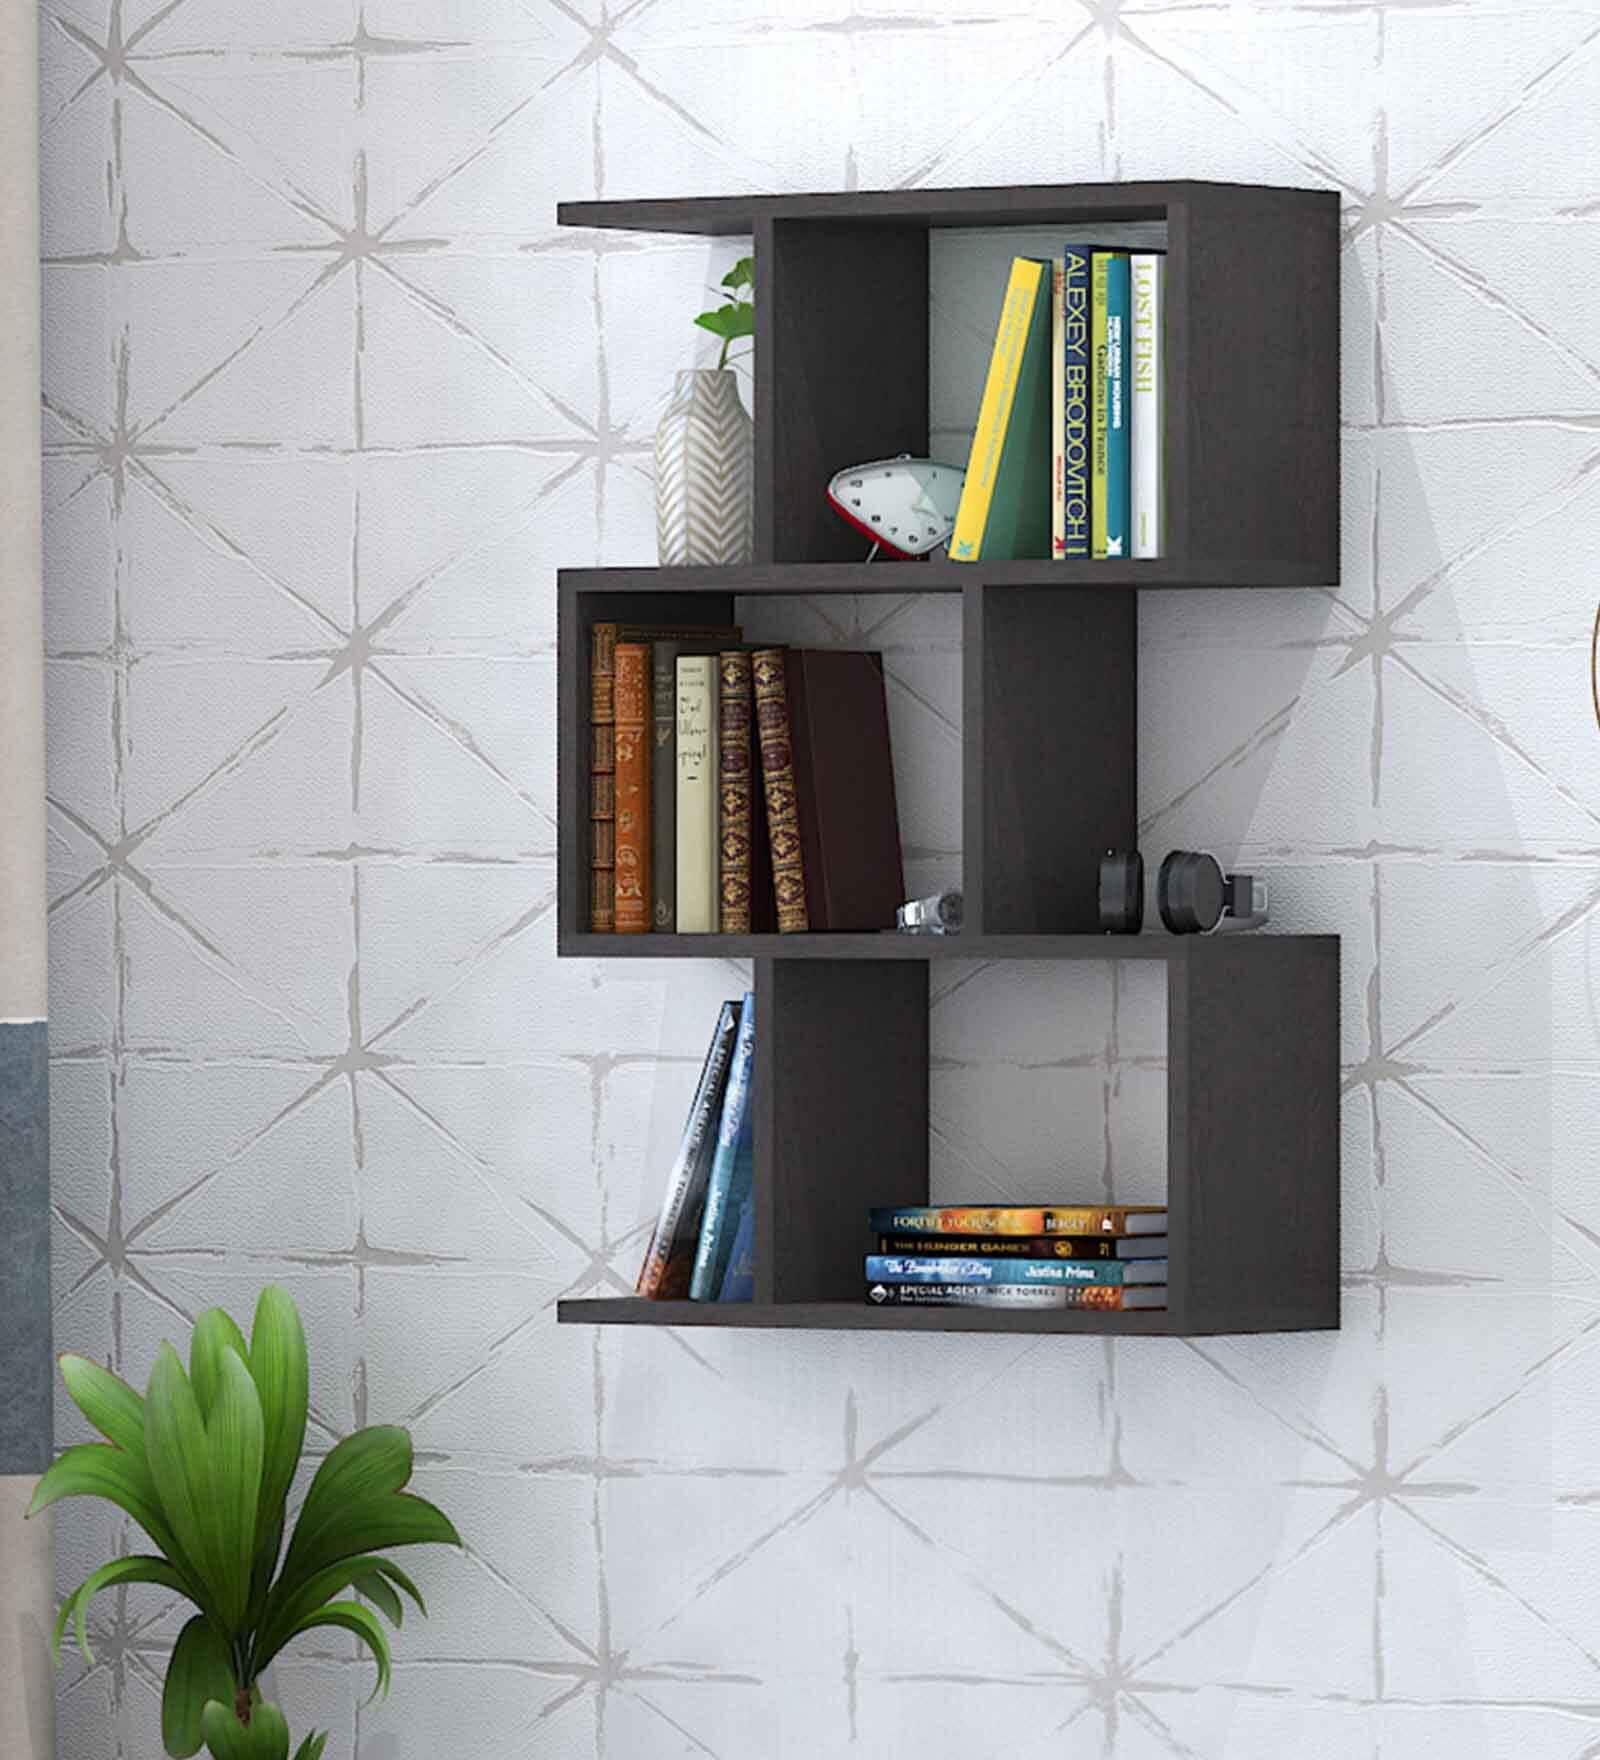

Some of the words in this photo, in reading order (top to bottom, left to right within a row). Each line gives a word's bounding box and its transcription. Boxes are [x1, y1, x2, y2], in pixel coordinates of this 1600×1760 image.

[1066, 253, 1088, 357] ALEXEY
[1135, 263, 1154, 329] LOST
[1135, 337, 1154, 393] FISH
[1066, 365, 1088, 539] BRODOVITCH
[900, 1285, 943, 1296] SPECIAL
[946, 1286, 981, 1296] AGENT
